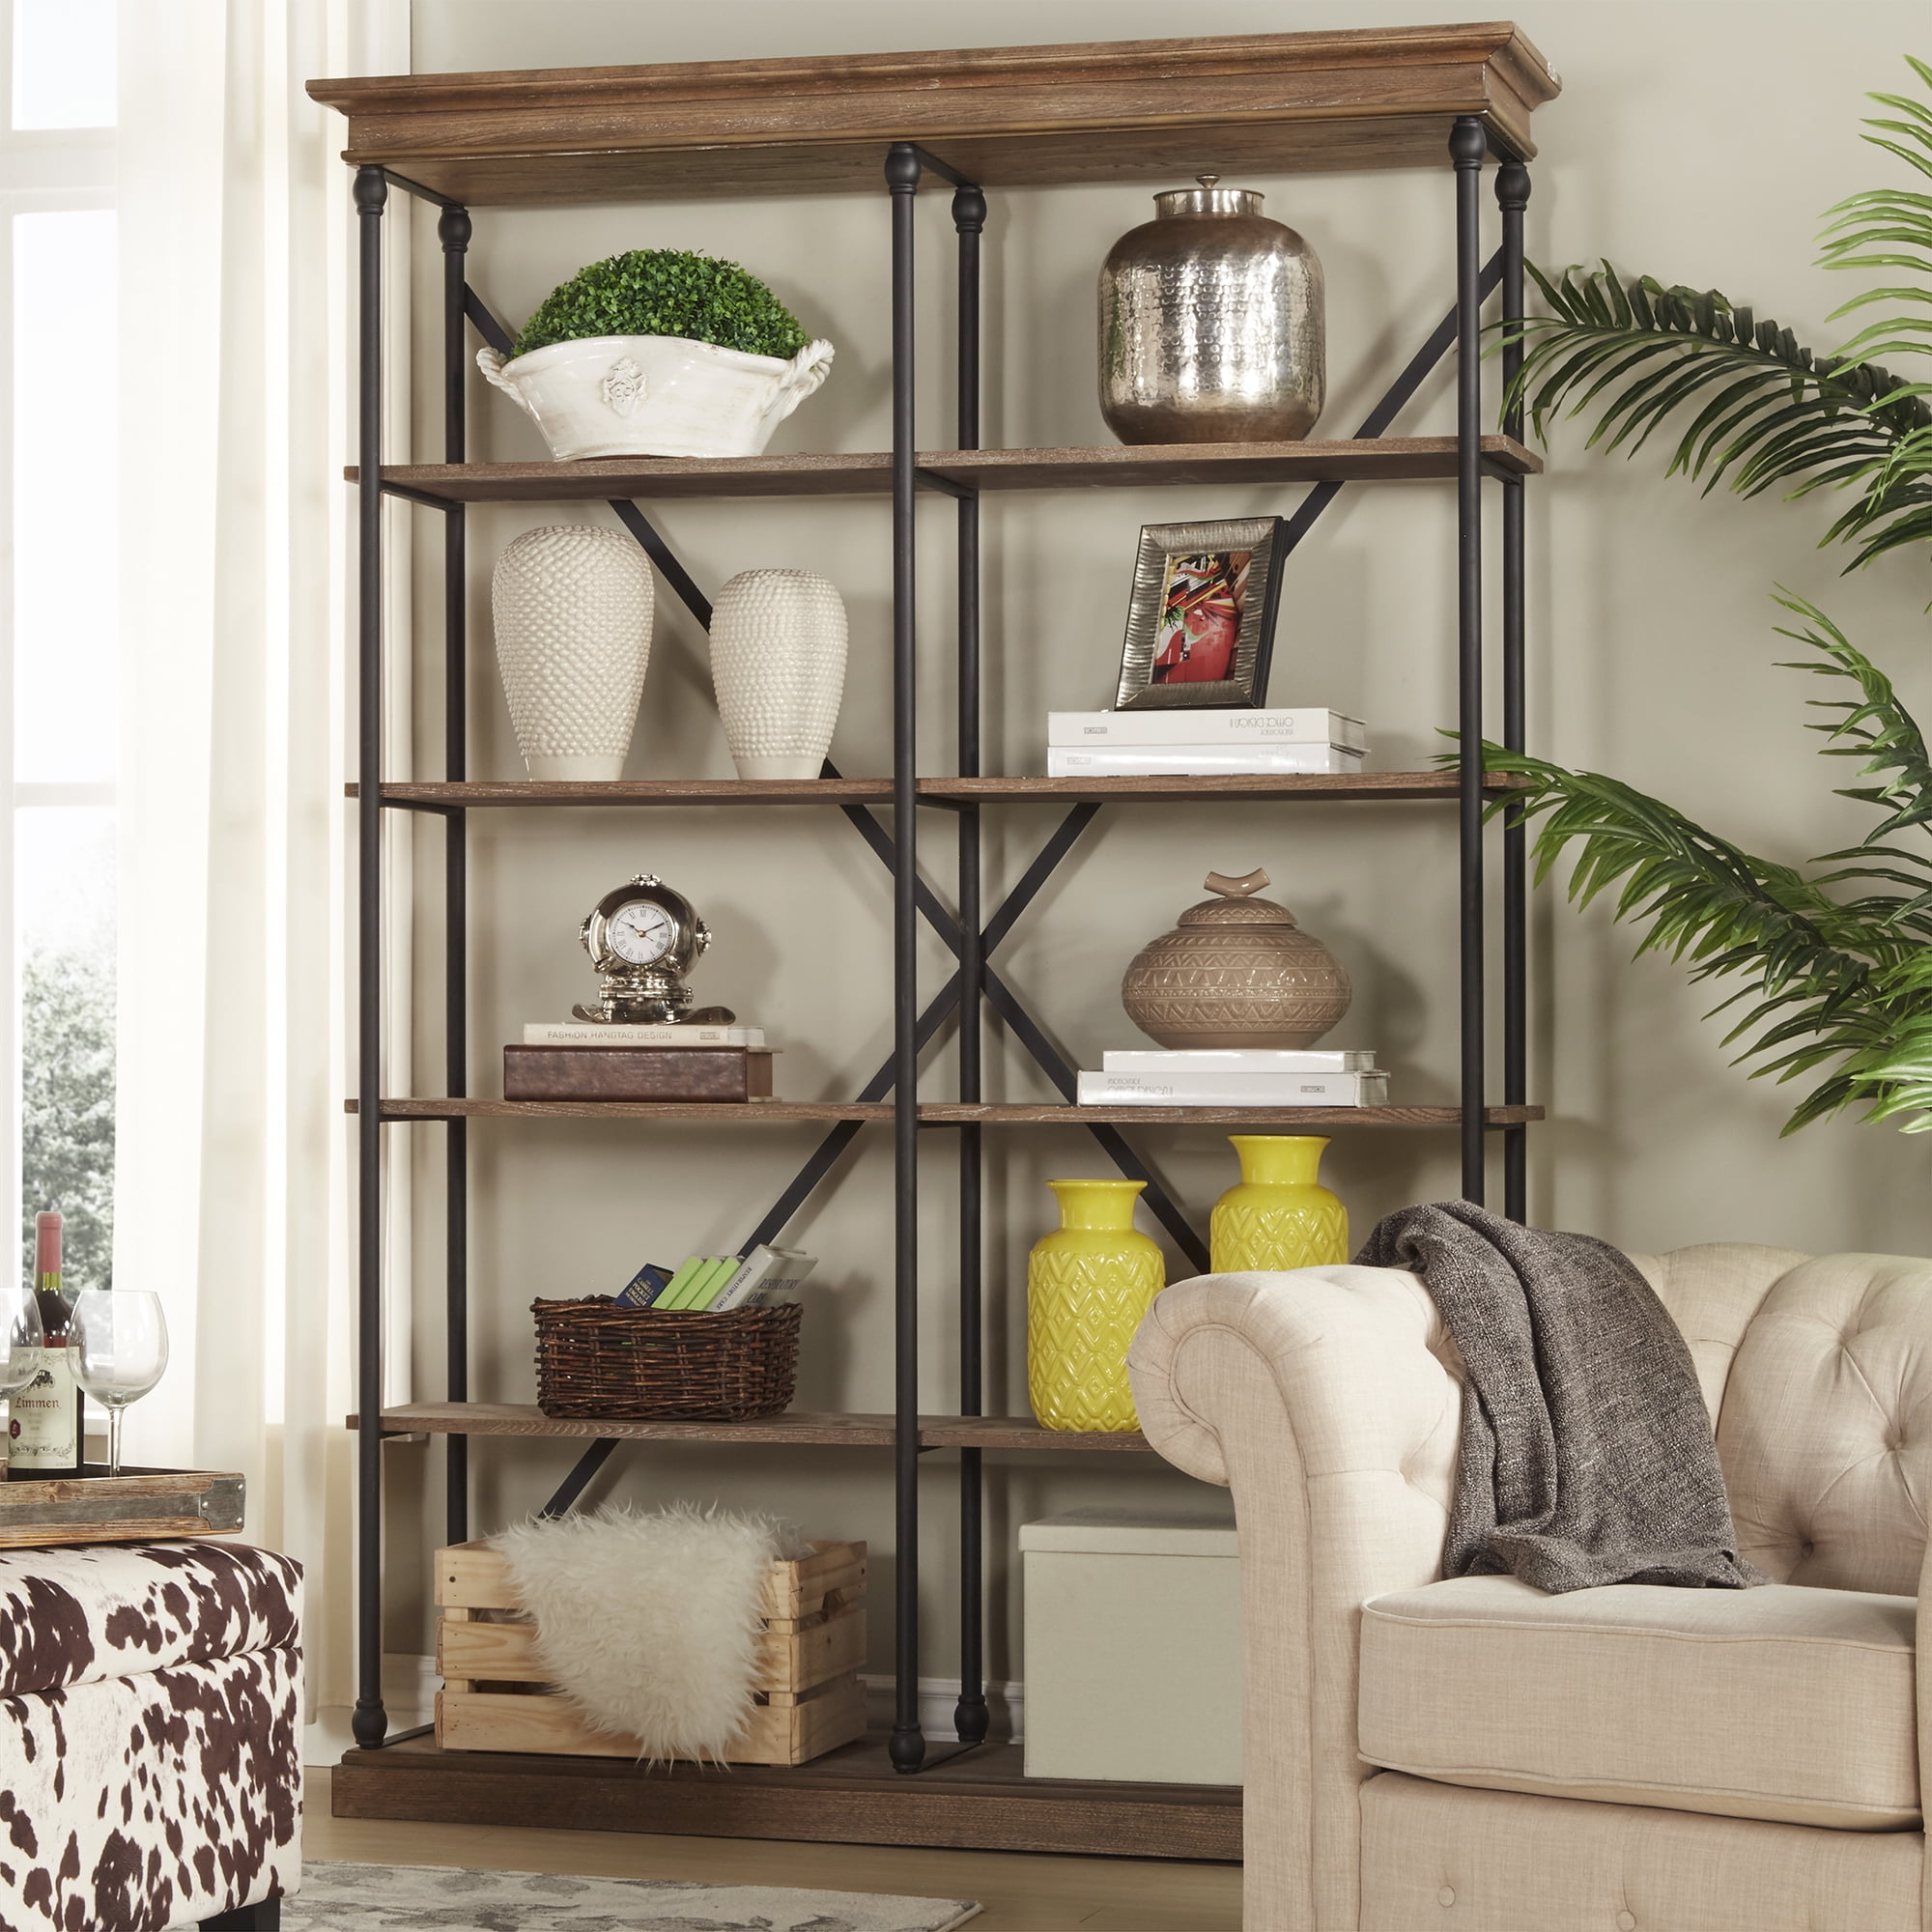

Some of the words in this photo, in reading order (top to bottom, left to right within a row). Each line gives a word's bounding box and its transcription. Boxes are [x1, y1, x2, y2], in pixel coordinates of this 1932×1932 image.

[548, 1031, 587, 1039] FASHION
[590, 1031, 634, 1040] HANGTAG
[637, 1031, 672, 1040] DESIGN
[14, 1396, 60, 1408] Limmen
